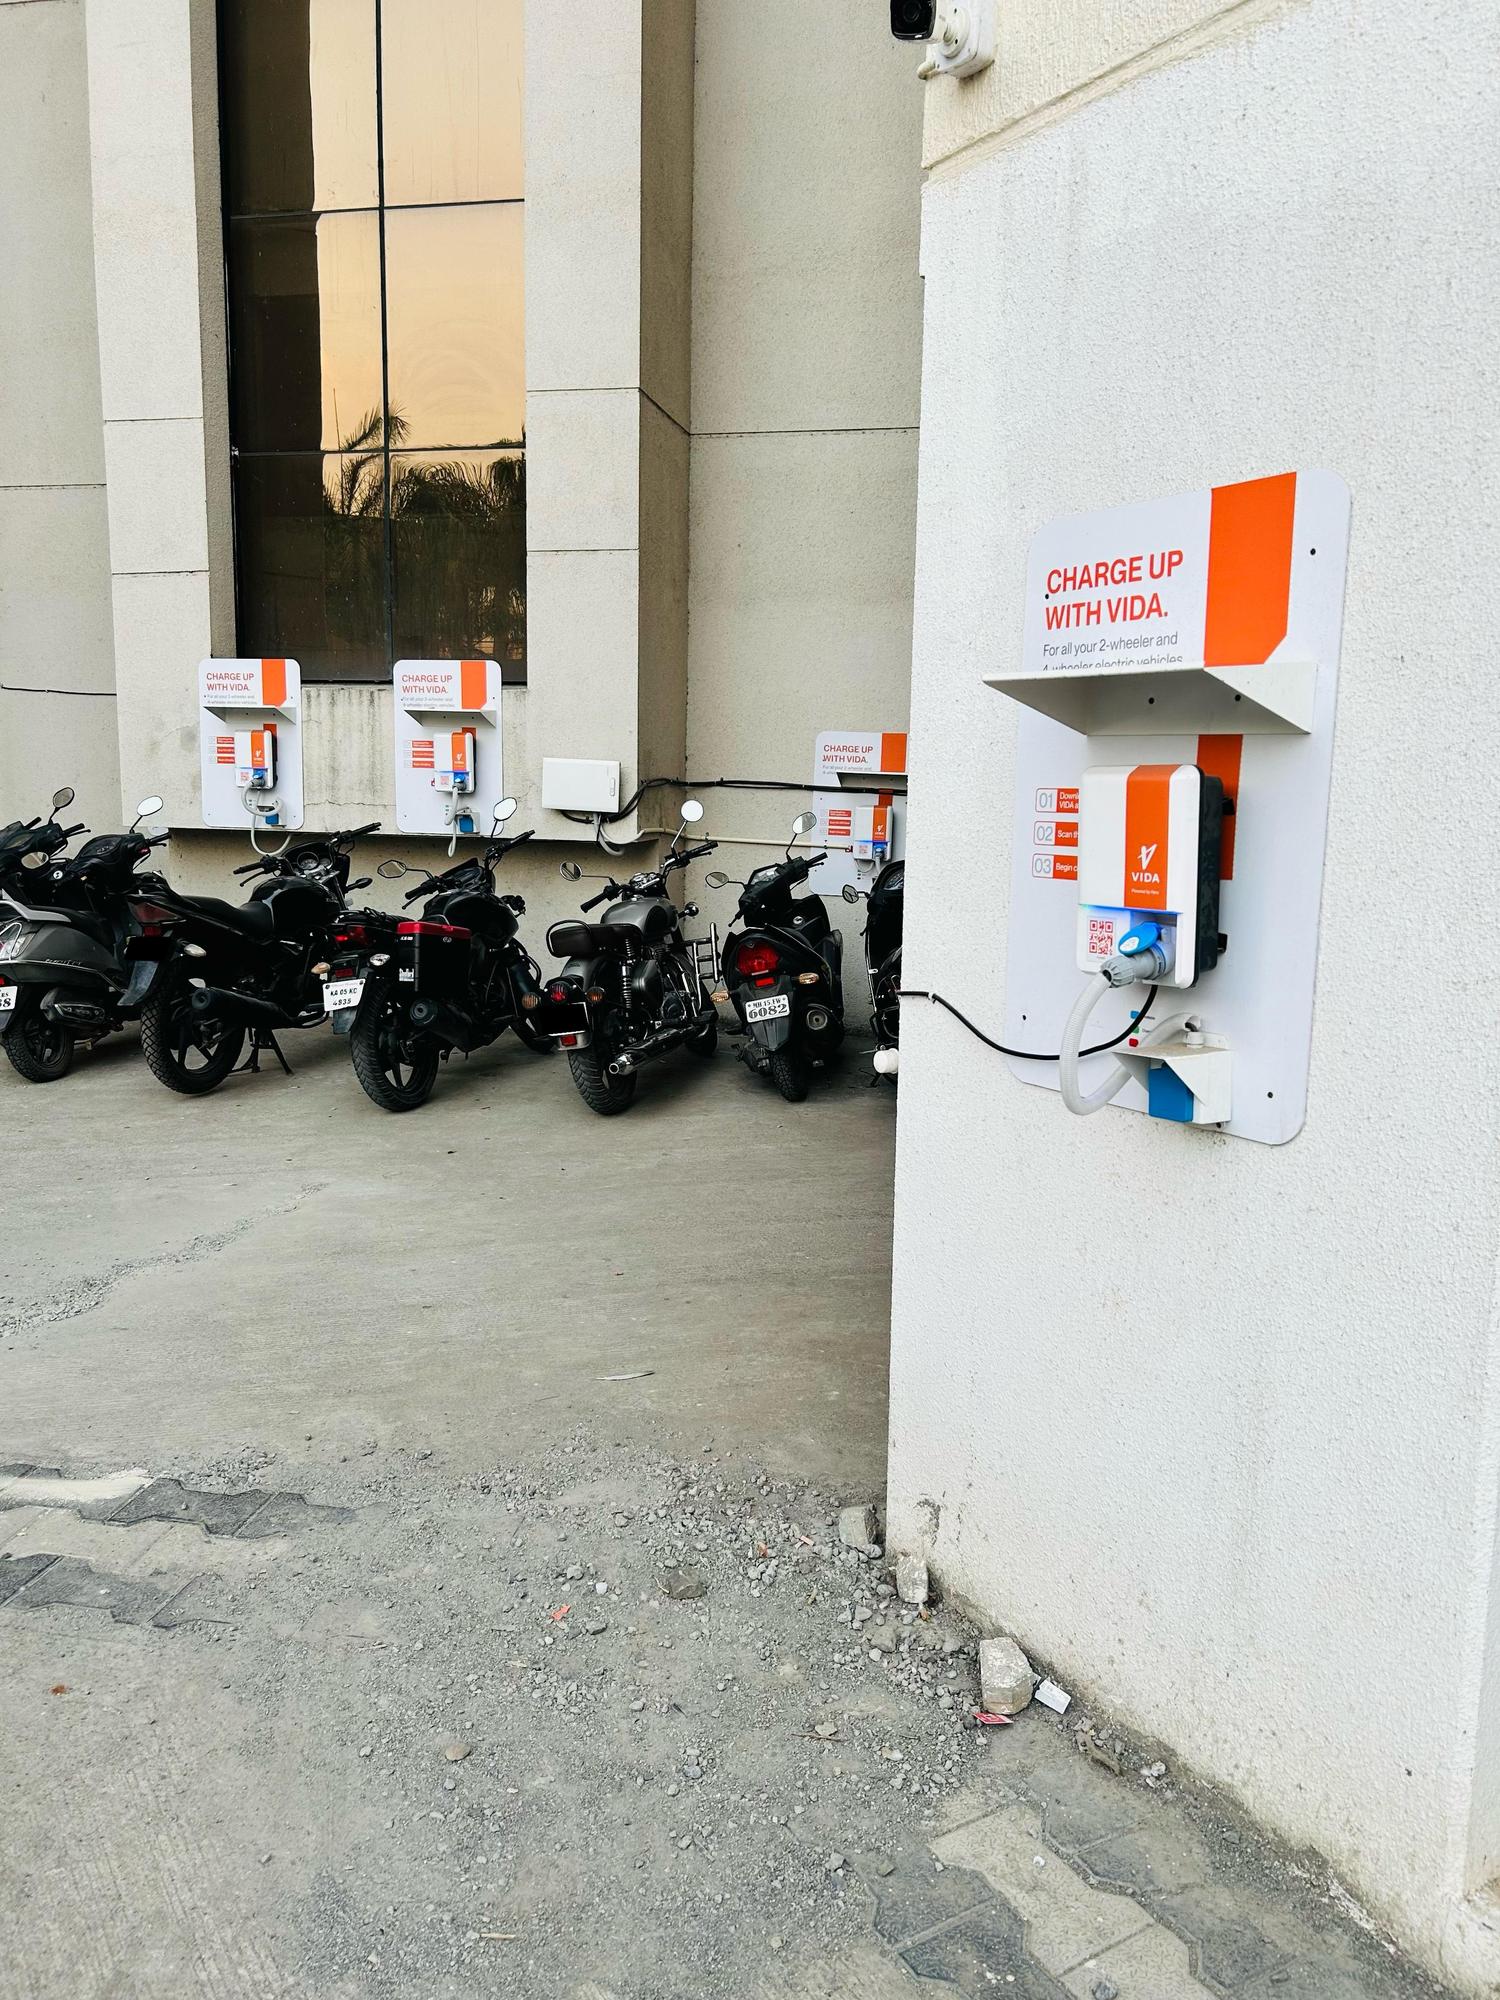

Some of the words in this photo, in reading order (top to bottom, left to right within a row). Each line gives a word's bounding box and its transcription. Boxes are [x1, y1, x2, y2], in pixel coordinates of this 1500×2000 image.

[1047, 556, 1144, 594] CHARGE
[1148, 549, 1184, 580] UP
[1045, 600, 1102, 630] WITH
[1106, 592, 1169, 623] VIDA.
[1043, 643, 1060, 657] For
[1060, 641, 1073, 655] all
[1074, 642, 1097, 657] your
[1099, 634, 1154, 652] 2-wheeler
[1155, 631, 1178, 646] and
[206, 672, 241, 681] CHARGE
[242, 672, 255, 681] UP
[401, 674, 439, 683] CHARGE
[440, 674, 453, 683] UP
[206, 683, 228, 691] WITH
[401, 685, 425, 694] WITH
[823, 744, 860, 753] CHARGE
[861, 745, 874, 754] UP
[823, 754, 846, 763] WITH
[846, 755, 868, 764] VIDA.
[1039, 792, 1053, 809] 01
[1058, 800, 1074, 809] VIDA
[1036, 825, 1053, 841] 02
[1057, 830, 1073, 839] Scan
[1034, 858, 1051, 874] 03
[1055, 862, 1073, 873] Begin
[1131, 871, 1160, 884] VIDA
[748, 1003, 788, 1019] 6082
